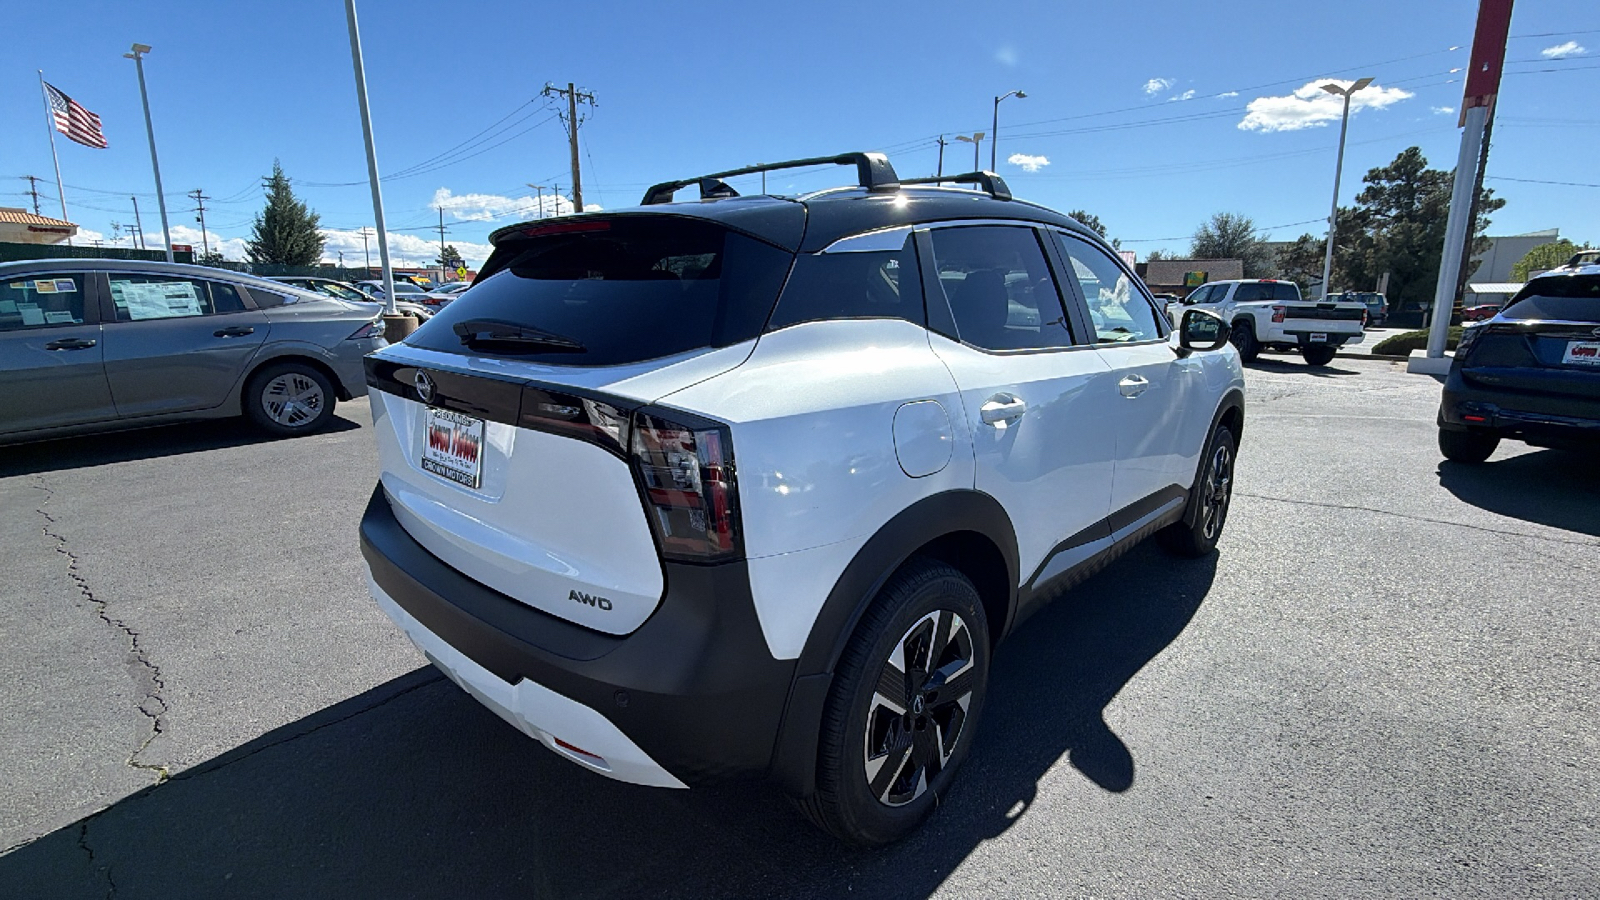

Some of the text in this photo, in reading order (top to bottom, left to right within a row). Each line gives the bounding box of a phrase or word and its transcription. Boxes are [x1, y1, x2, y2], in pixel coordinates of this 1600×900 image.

[424, 461, 473, 486] CROWN MOTORS
[568, 589, 613, 611] AWD
